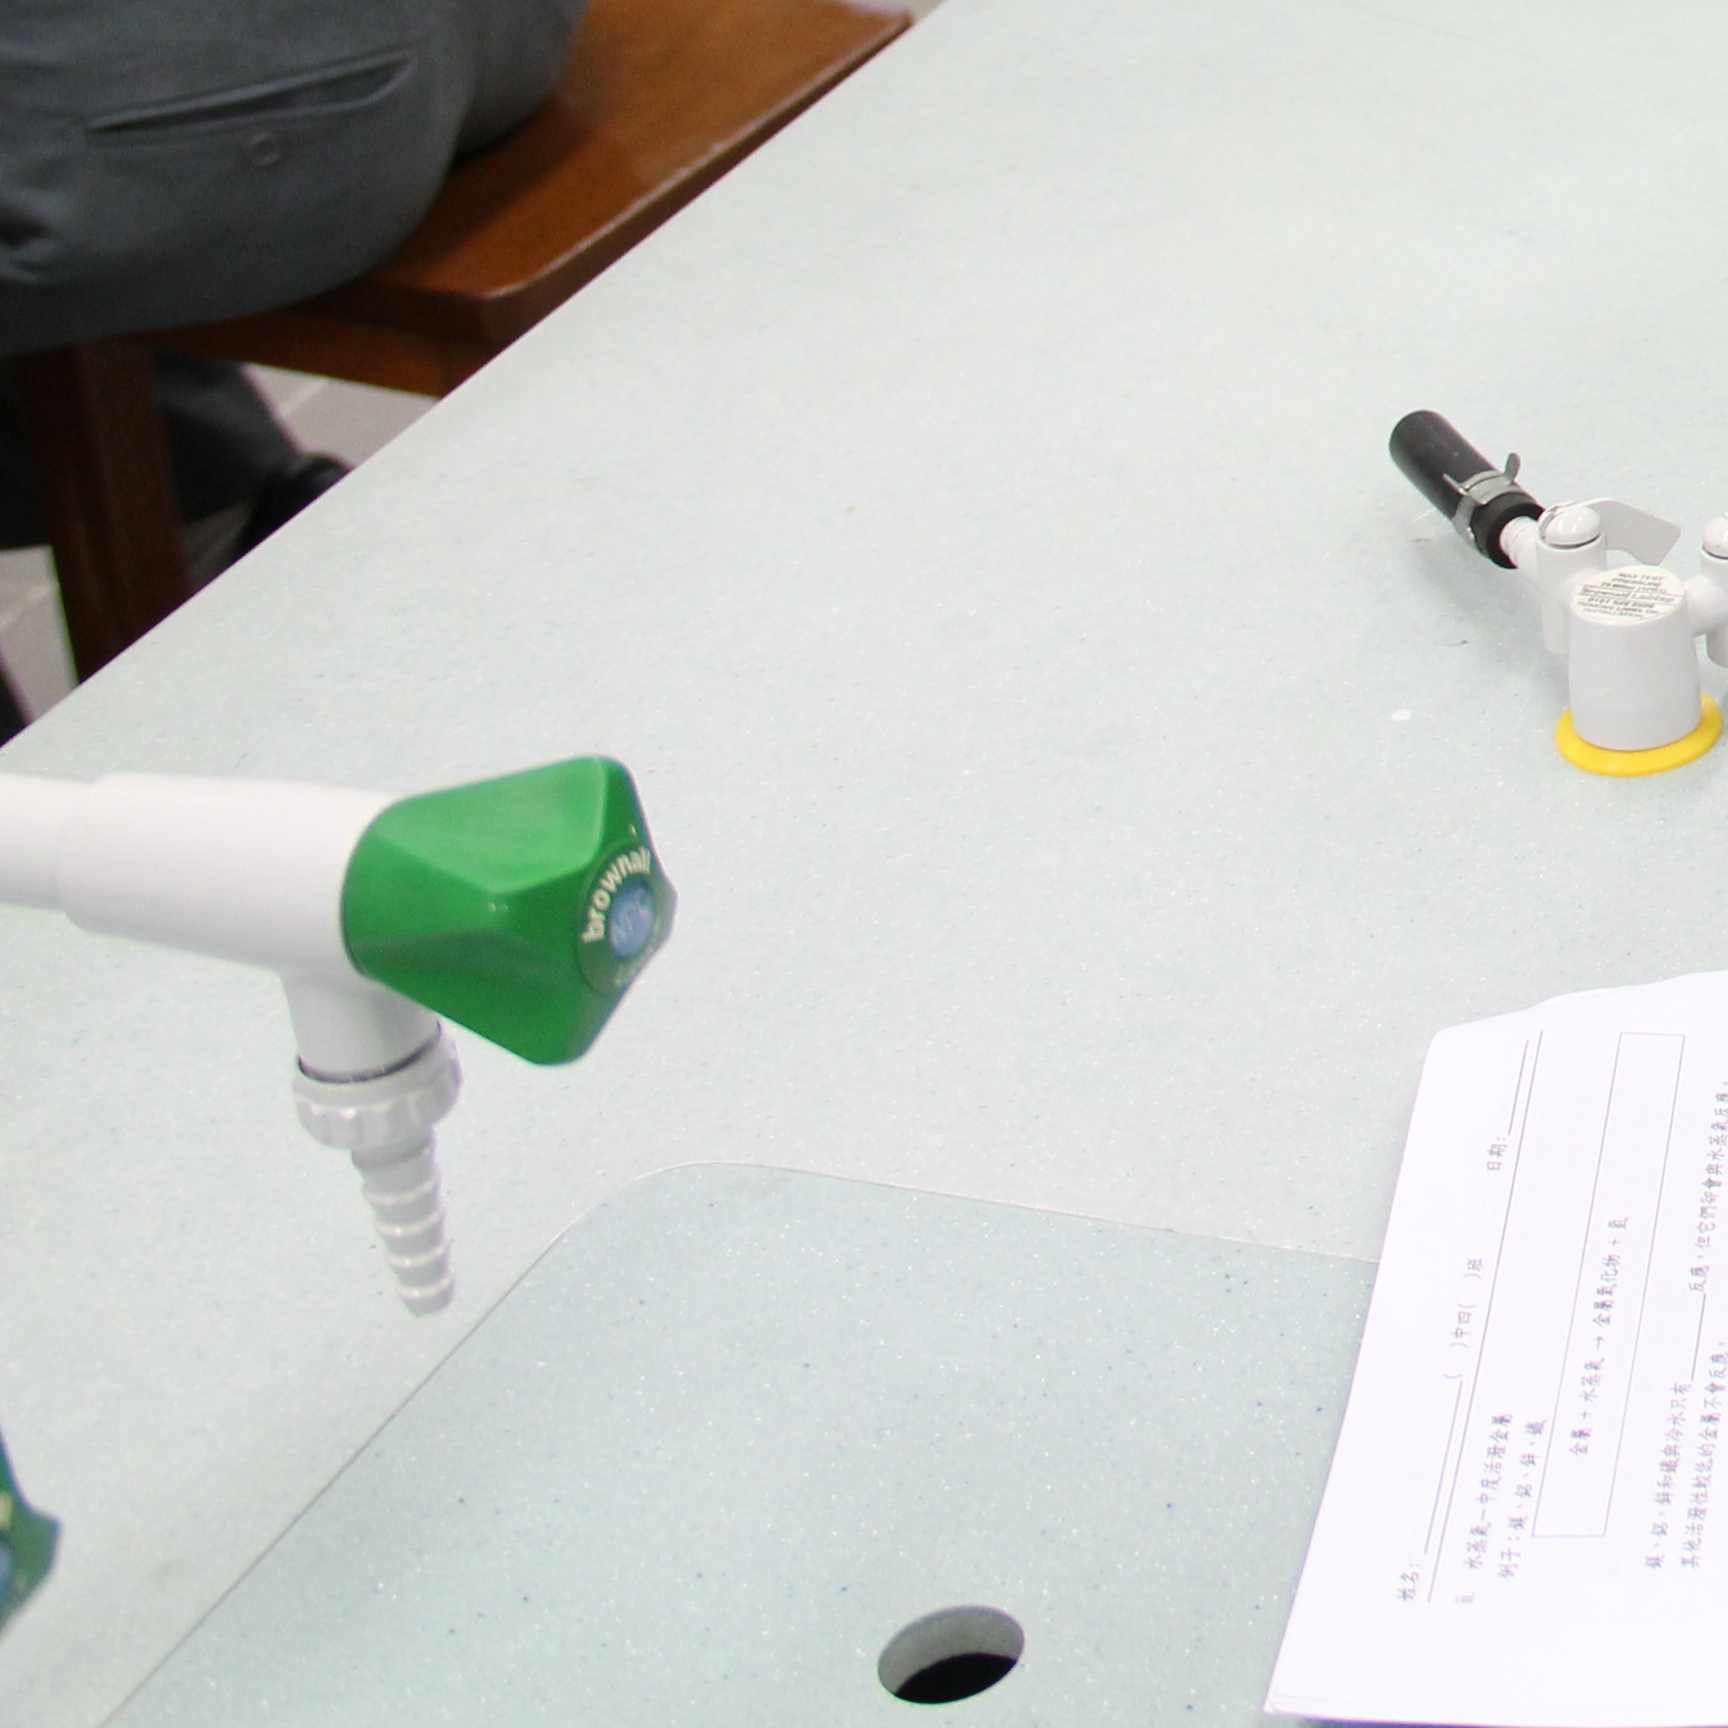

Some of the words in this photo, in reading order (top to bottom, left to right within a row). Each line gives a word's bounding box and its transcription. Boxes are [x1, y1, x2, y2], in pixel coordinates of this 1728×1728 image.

[582, 844, 652, 945] brownall
[1588, 1252, 1623, 1327] 金屬氧化物
[1576, 1356, 1606, 1403] 水蒸氣
